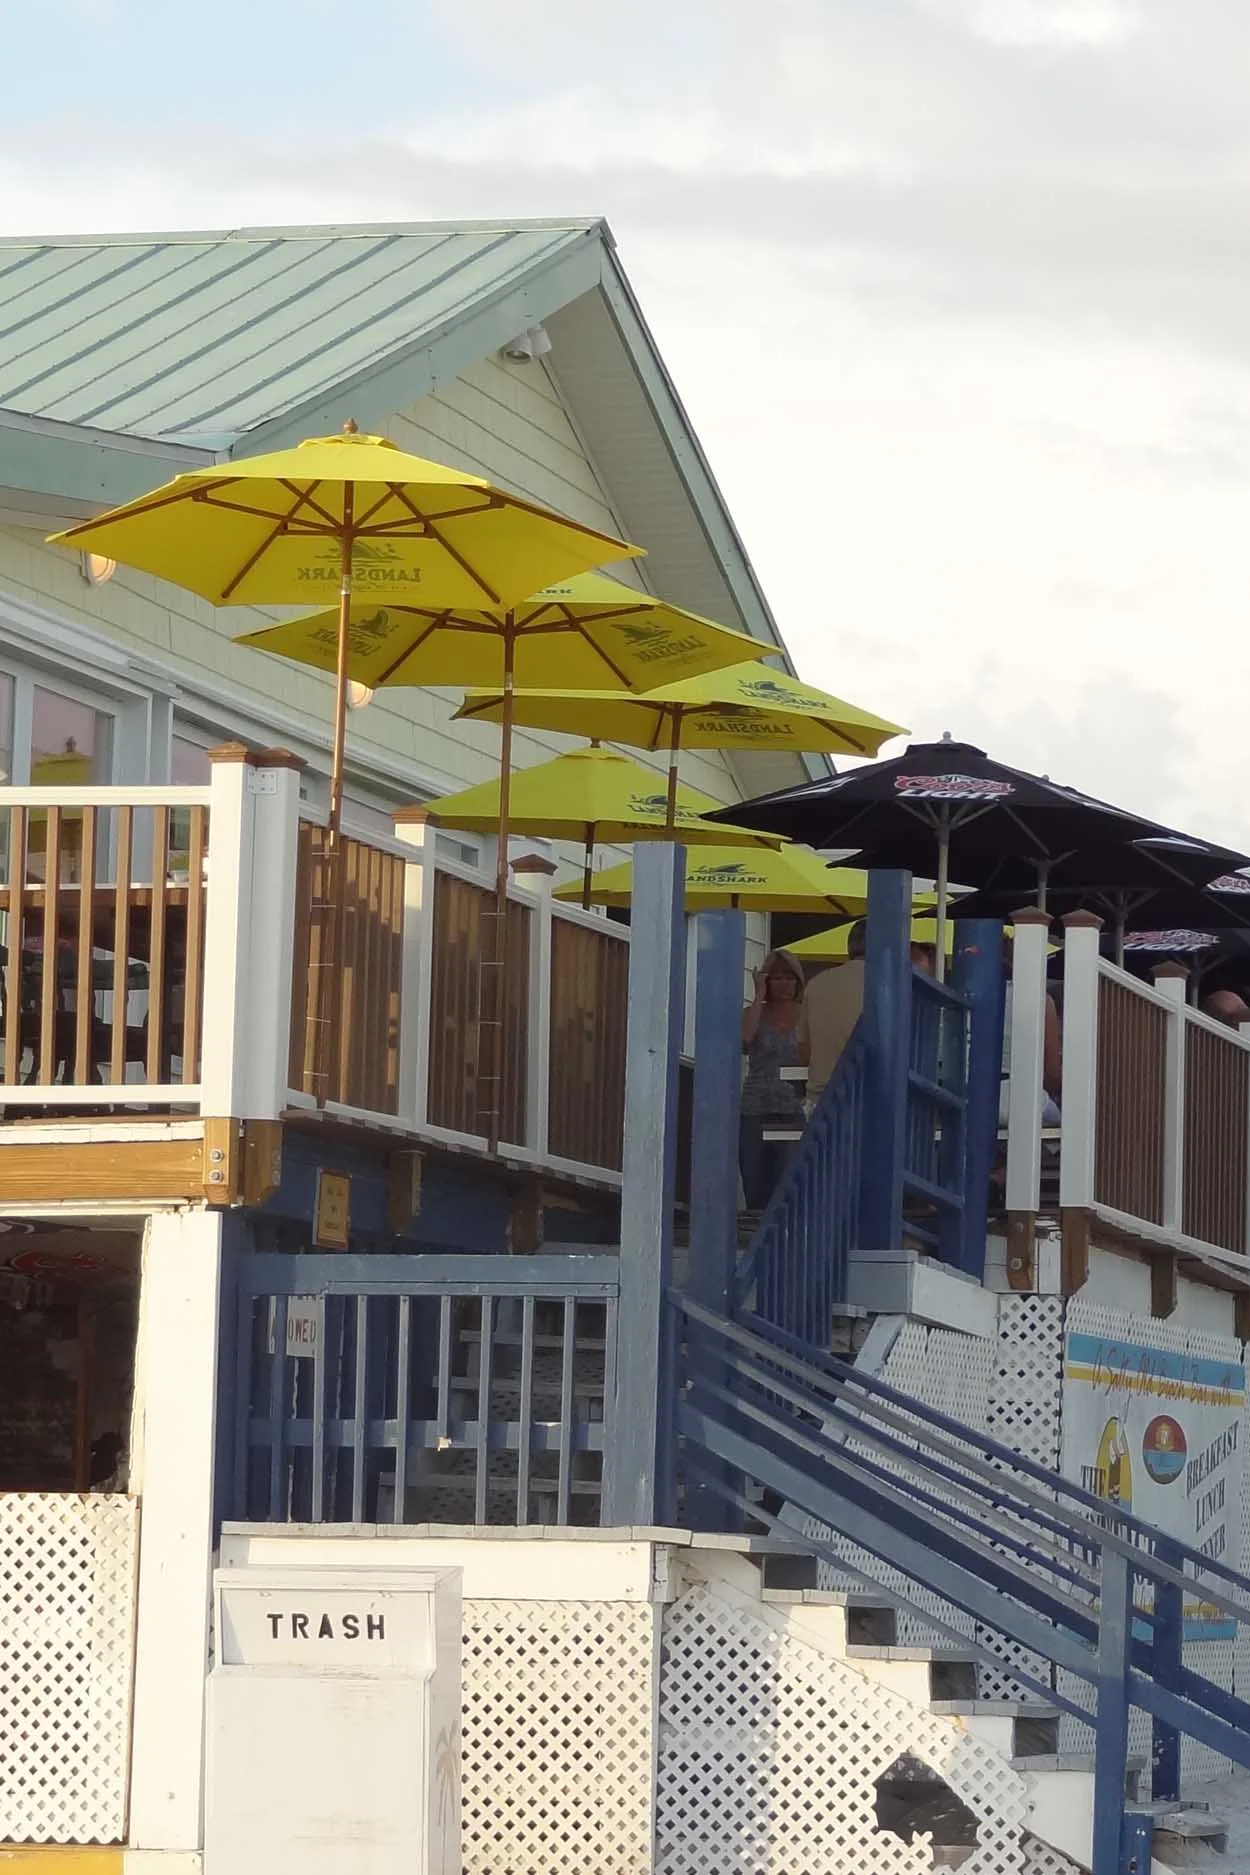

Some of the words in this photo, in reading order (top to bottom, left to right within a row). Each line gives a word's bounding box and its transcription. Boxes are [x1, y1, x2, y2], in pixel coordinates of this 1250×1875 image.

[896, 789, 1009, 801] LIGHT
[686, 875, 768, 884] ANDSHARK
[1186, 1421, 1239, 1497] BREAKFAST
[1196, 1478, 1226, 1532] LUNCH
[266, 1613, 385, 1640] TRASH
